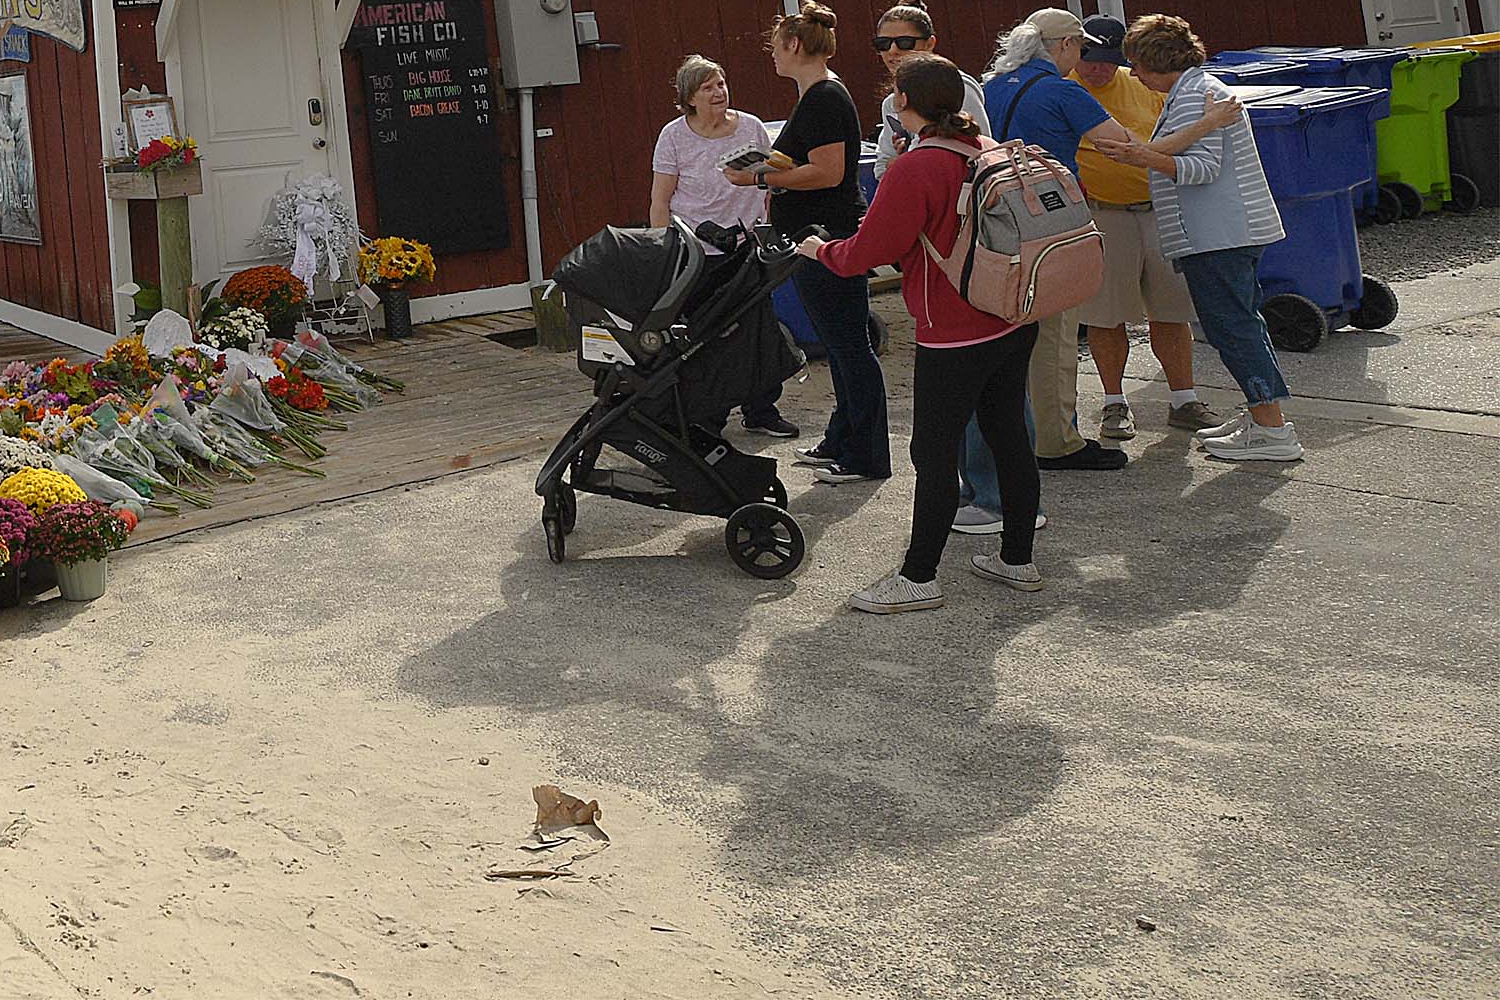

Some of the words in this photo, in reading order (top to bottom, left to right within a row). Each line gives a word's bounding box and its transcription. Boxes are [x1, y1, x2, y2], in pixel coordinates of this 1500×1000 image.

[355, 1, 446, 27] AMERICAN
[376, 23, 424, 46] FISH
[433, 21, 466, 42] CO.
[396, 51, 419, 66] LIVE
[425, 47, 451, 63] MUSIC
[408, 71, 427, 86] BIG
[429, 69, 453, 84] HOUSE
[443, 84, 462, 97] BAND
[375, 107, 394, 122] SAT
[409, 103, 434, 118] BACON
[378, 129, 398, 143] SUN
